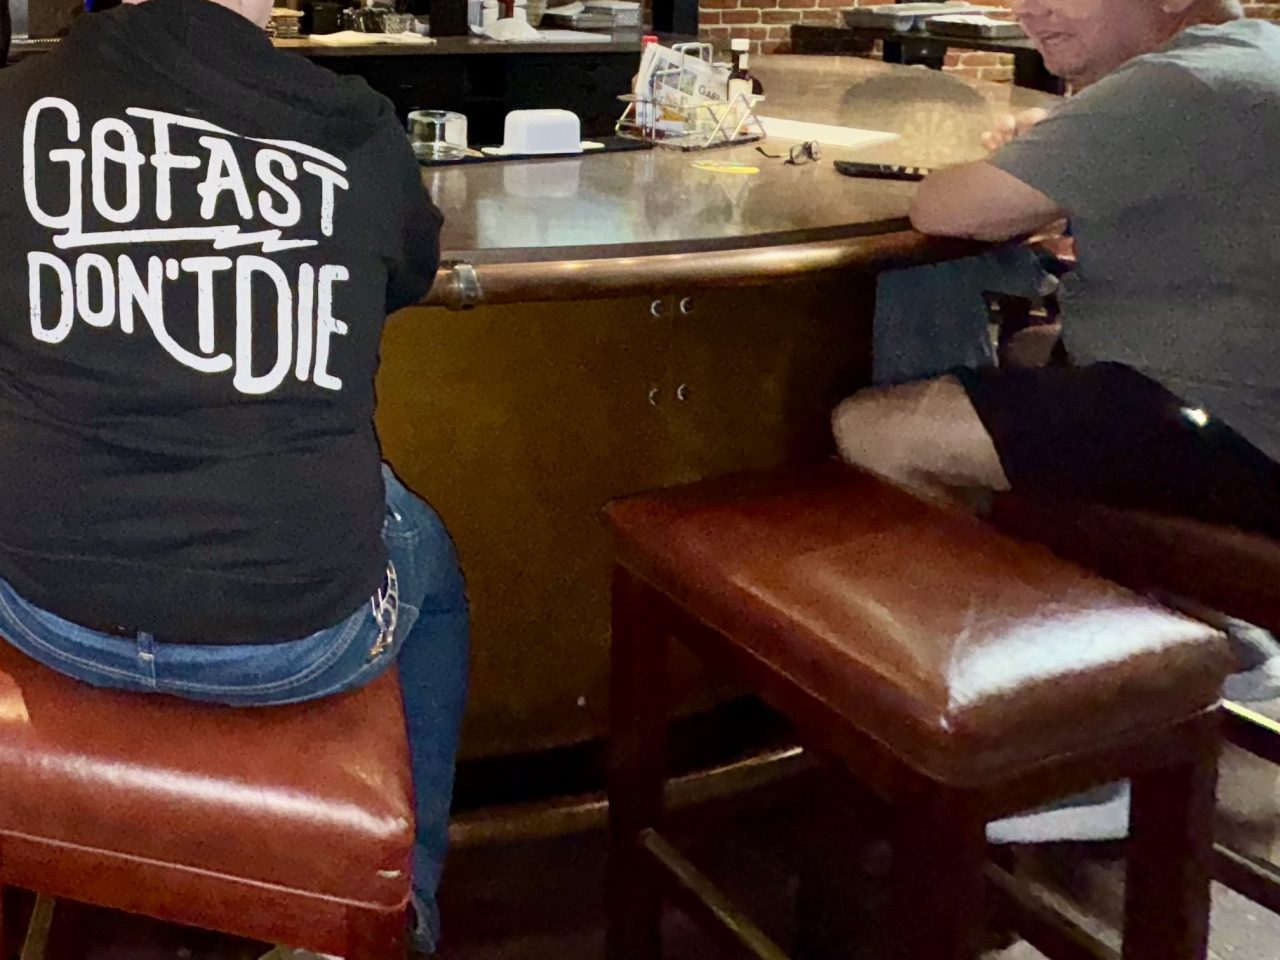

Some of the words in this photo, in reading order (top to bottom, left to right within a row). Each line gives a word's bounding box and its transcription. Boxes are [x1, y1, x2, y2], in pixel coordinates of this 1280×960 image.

[23, 96, 145, 235] GO
[125, 106, 350, 237] FAST
[27, 251, 233, 373] DON'T
[233, 255, 350, 394] DIE
